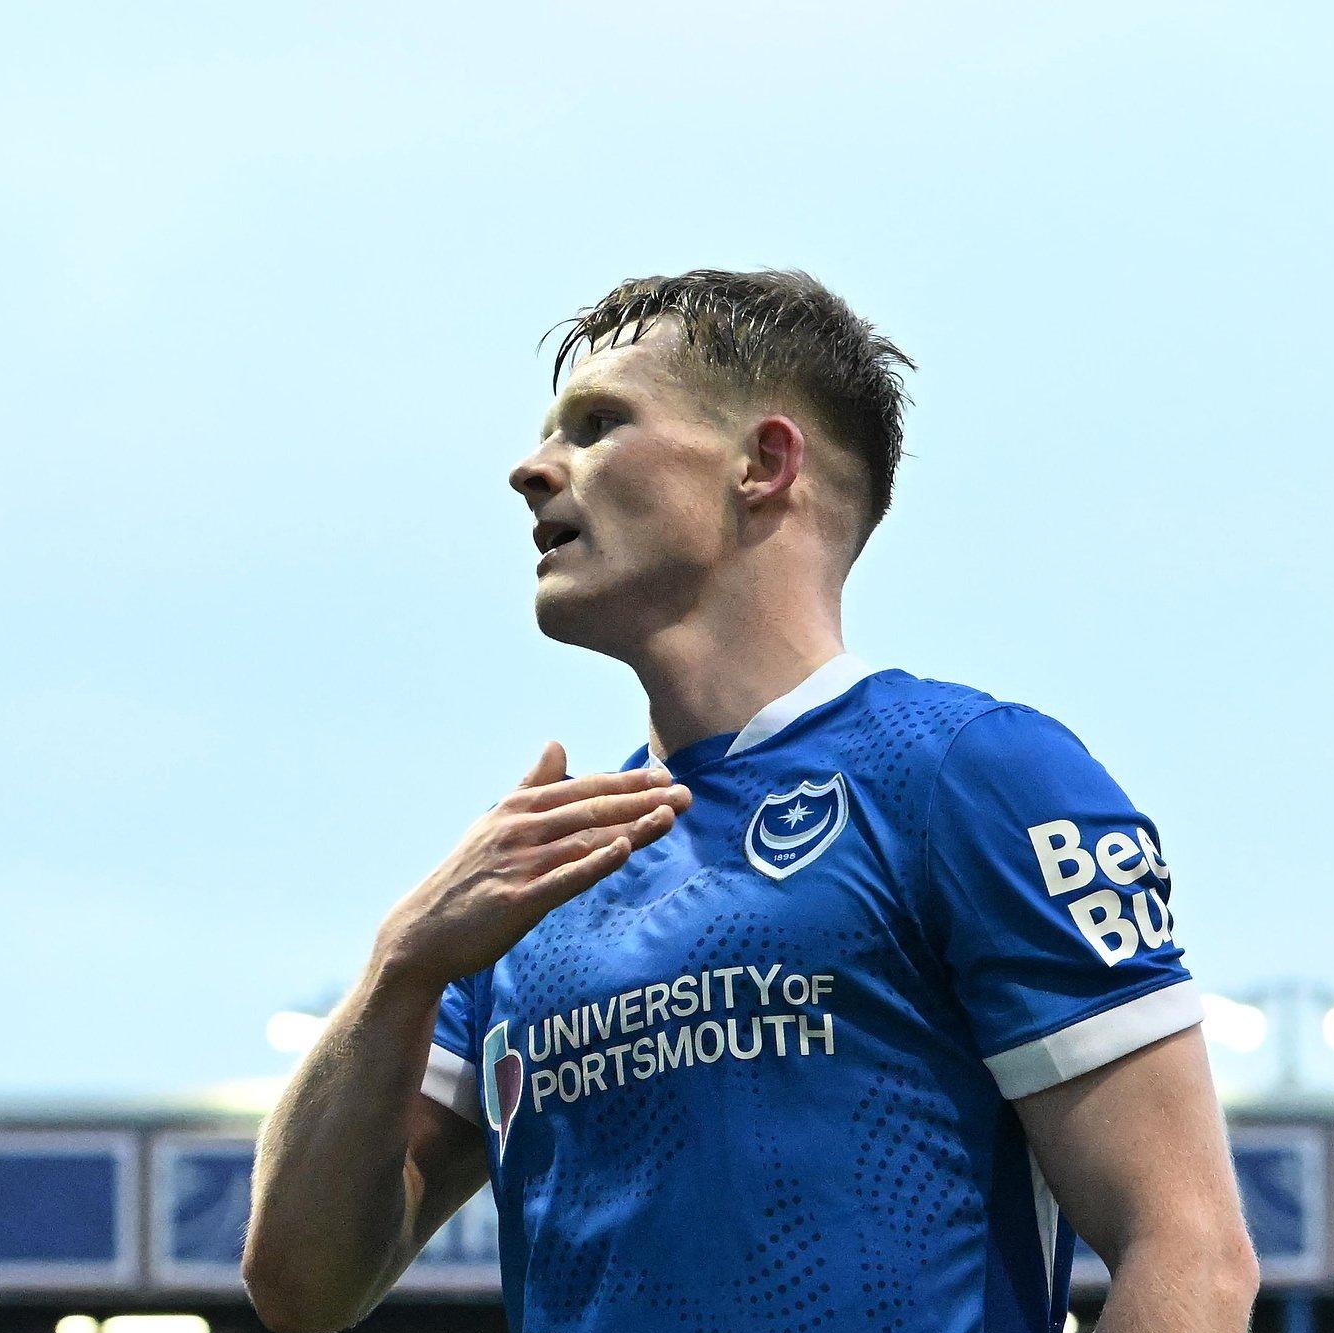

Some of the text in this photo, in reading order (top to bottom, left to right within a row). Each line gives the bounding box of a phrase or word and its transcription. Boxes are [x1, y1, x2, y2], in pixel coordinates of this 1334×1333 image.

[773, 852, 797, 862] 1898
[528, 964, 835, 1062] UNIVERSITY OF
[531, 1013, 836, 1113] PORTSMOUTH
